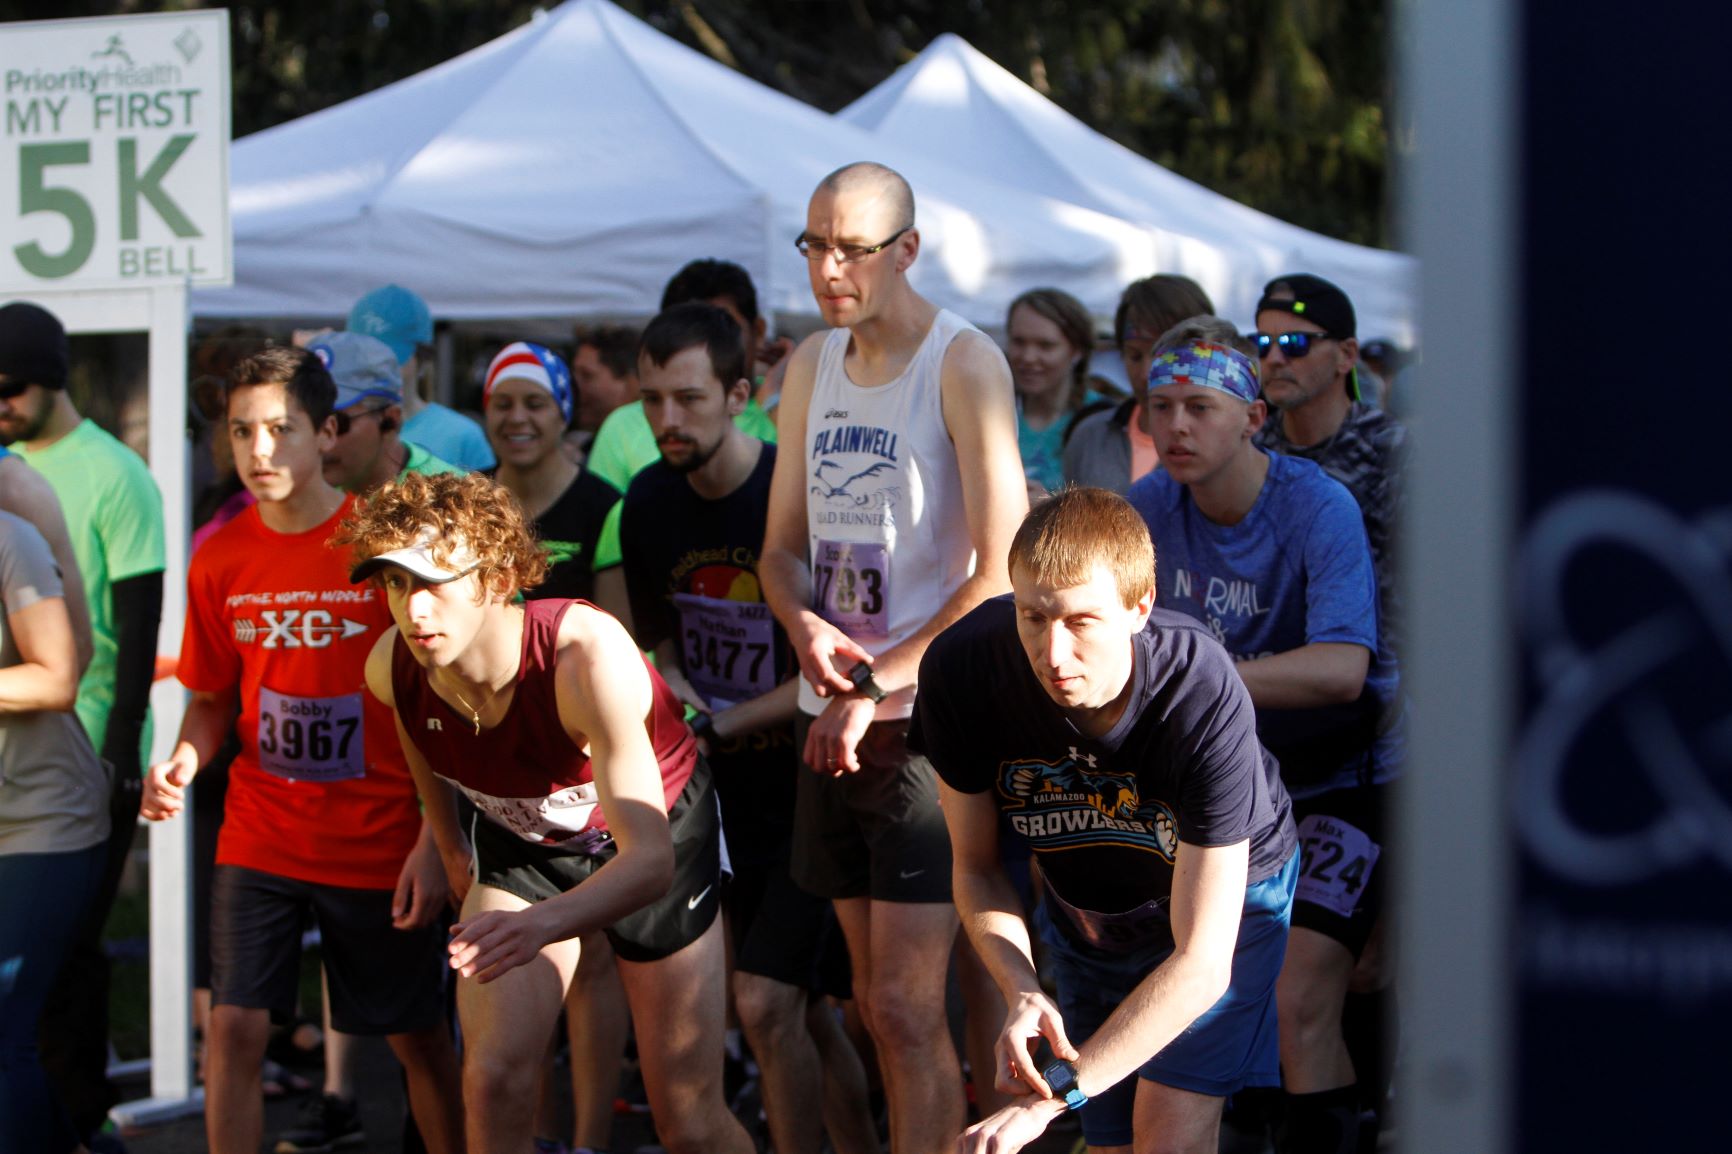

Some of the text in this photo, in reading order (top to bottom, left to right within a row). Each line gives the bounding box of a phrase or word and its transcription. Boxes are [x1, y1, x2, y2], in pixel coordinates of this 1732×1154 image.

[7, 89, 201, 134] MY FIRST
[12, 133, 204, 280] 5K
[119, 246, 206, 277] BELL
[813, 426, 897, 462] PLAINWELL
[274, 590, 317, 605] NORTH
[261, 610, 332, 648] XC
[700, 617, 747, 638] Nathan
[686, 629, 769, 683] 3477
[280, 699, 332, 718] Bobby
[260, 711, 359, 761] 3967
[1033, 793, 1085, 804] KALAMAZOO
[1012, 809, 1148, 837] GROWLERS
[1314, 820, 1345, 839] Max
